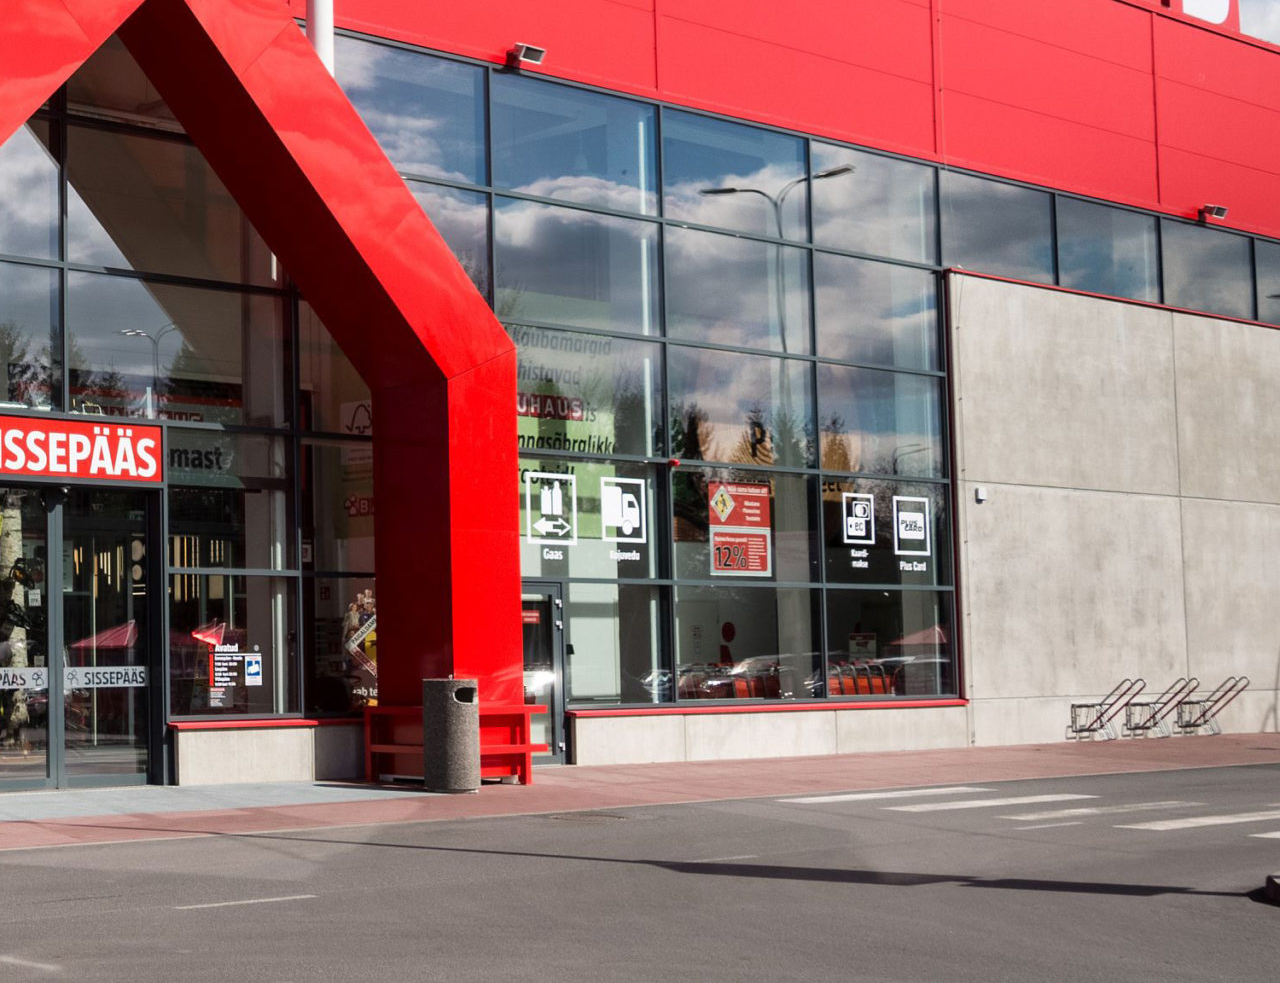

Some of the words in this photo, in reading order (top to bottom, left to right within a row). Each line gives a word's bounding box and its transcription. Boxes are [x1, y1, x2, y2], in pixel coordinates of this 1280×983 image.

[543, 548, 563, 560] Gaas
[715, 546, 747, 568] 12%
[900, 561, 912, 571] Plus
[913, 561, 926, 571] Card
[84, 668, 145, 685] SISSEPÄÄS
